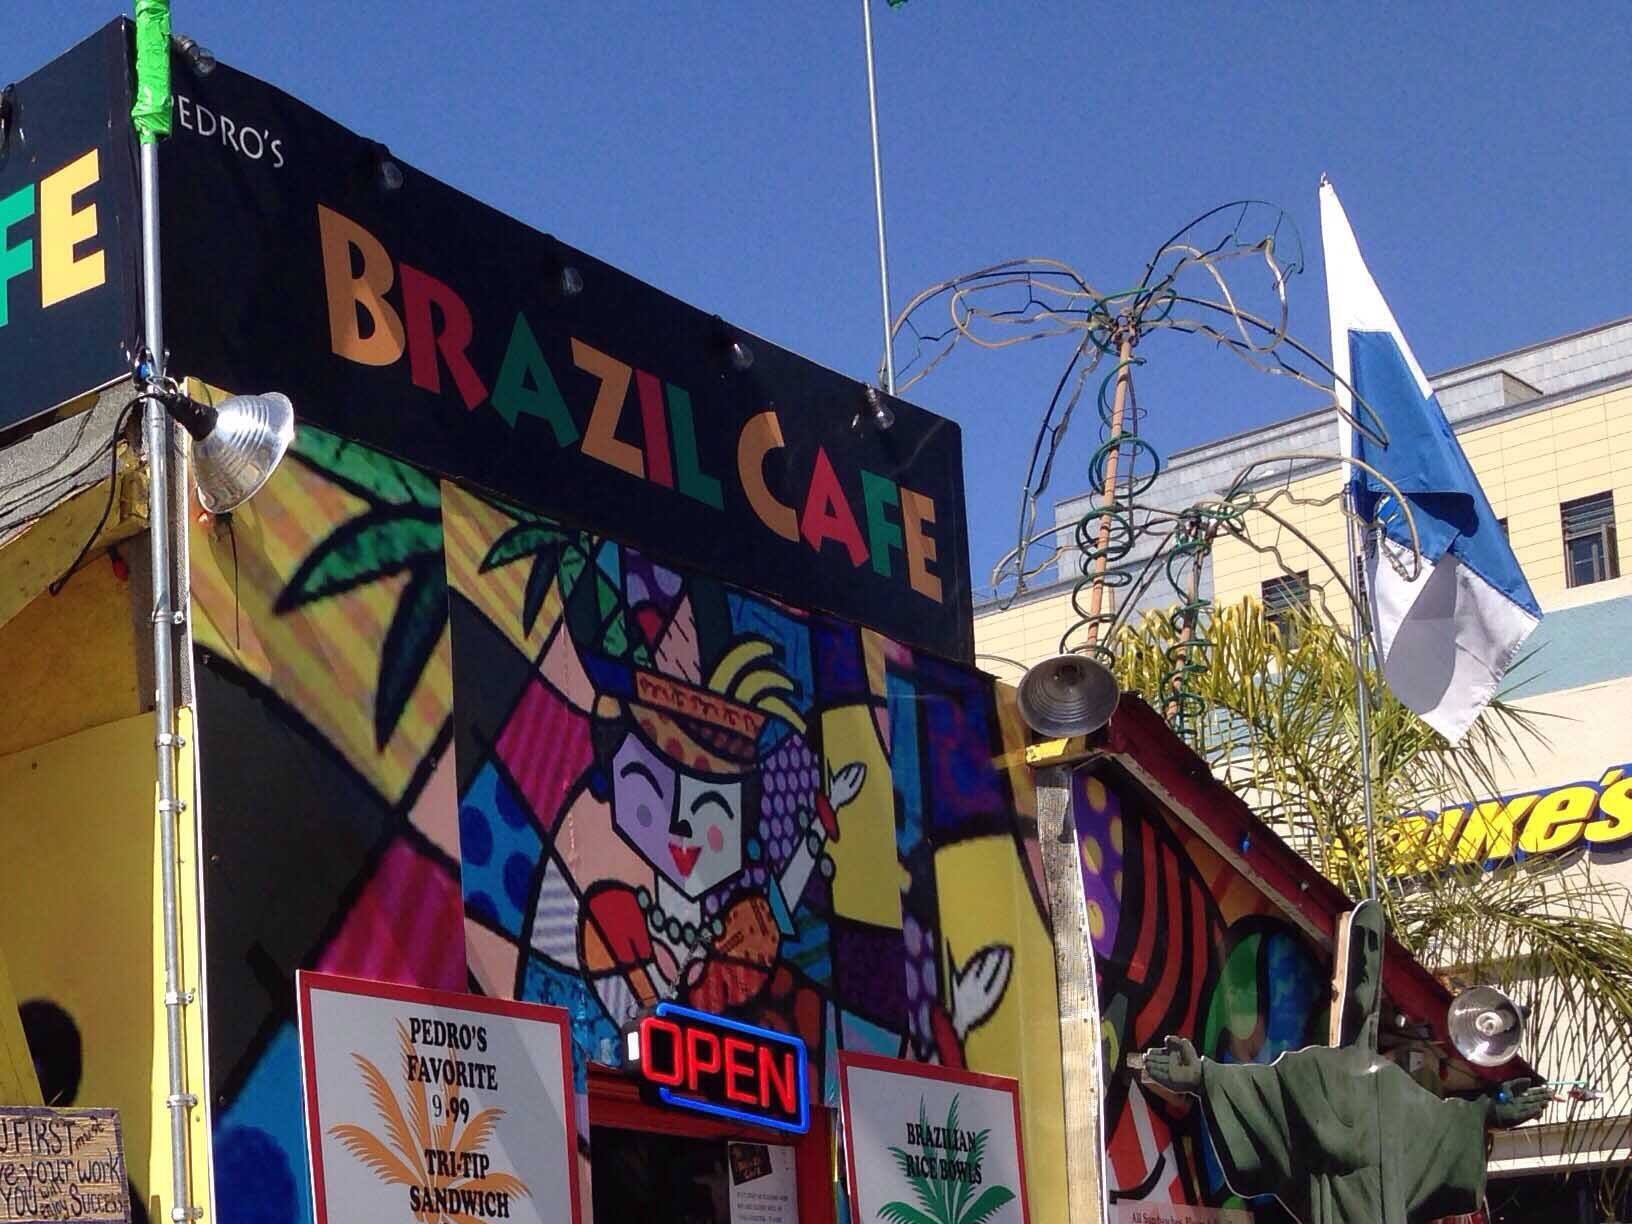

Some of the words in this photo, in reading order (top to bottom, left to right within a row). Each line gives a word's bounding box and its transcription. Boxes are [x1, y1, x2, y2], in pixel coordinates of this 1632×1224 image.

[170, 94, 284, 168] EDRO'S
[317, 203, 724, 511] BRAZIL
[737, 411, 942, 603] CAFE
[409, 1017, 488, 1052] PEDRO'S
[406, 1055, 499, 1091] FAVORITE
[640, 1016, 797, 1114] OPEN
[432, 1094, 469, 1124] 9.99
[14, 1118, 79, 1155] FIRST
[906, 1123, 977, 1153] BRAZILIAN
[20, 1158, 74, 1188] your
[76, 1150, 121, 1185] work
[425, 1148, 490, 1180] TRI-TIP
[906, 1155, 938, 1180] RICE
[940, 1159, 983, 1185] BOWLS
[0, 1185, 37, 1218] YOU
[409, 1185, 510, 1219] SANDWICH
